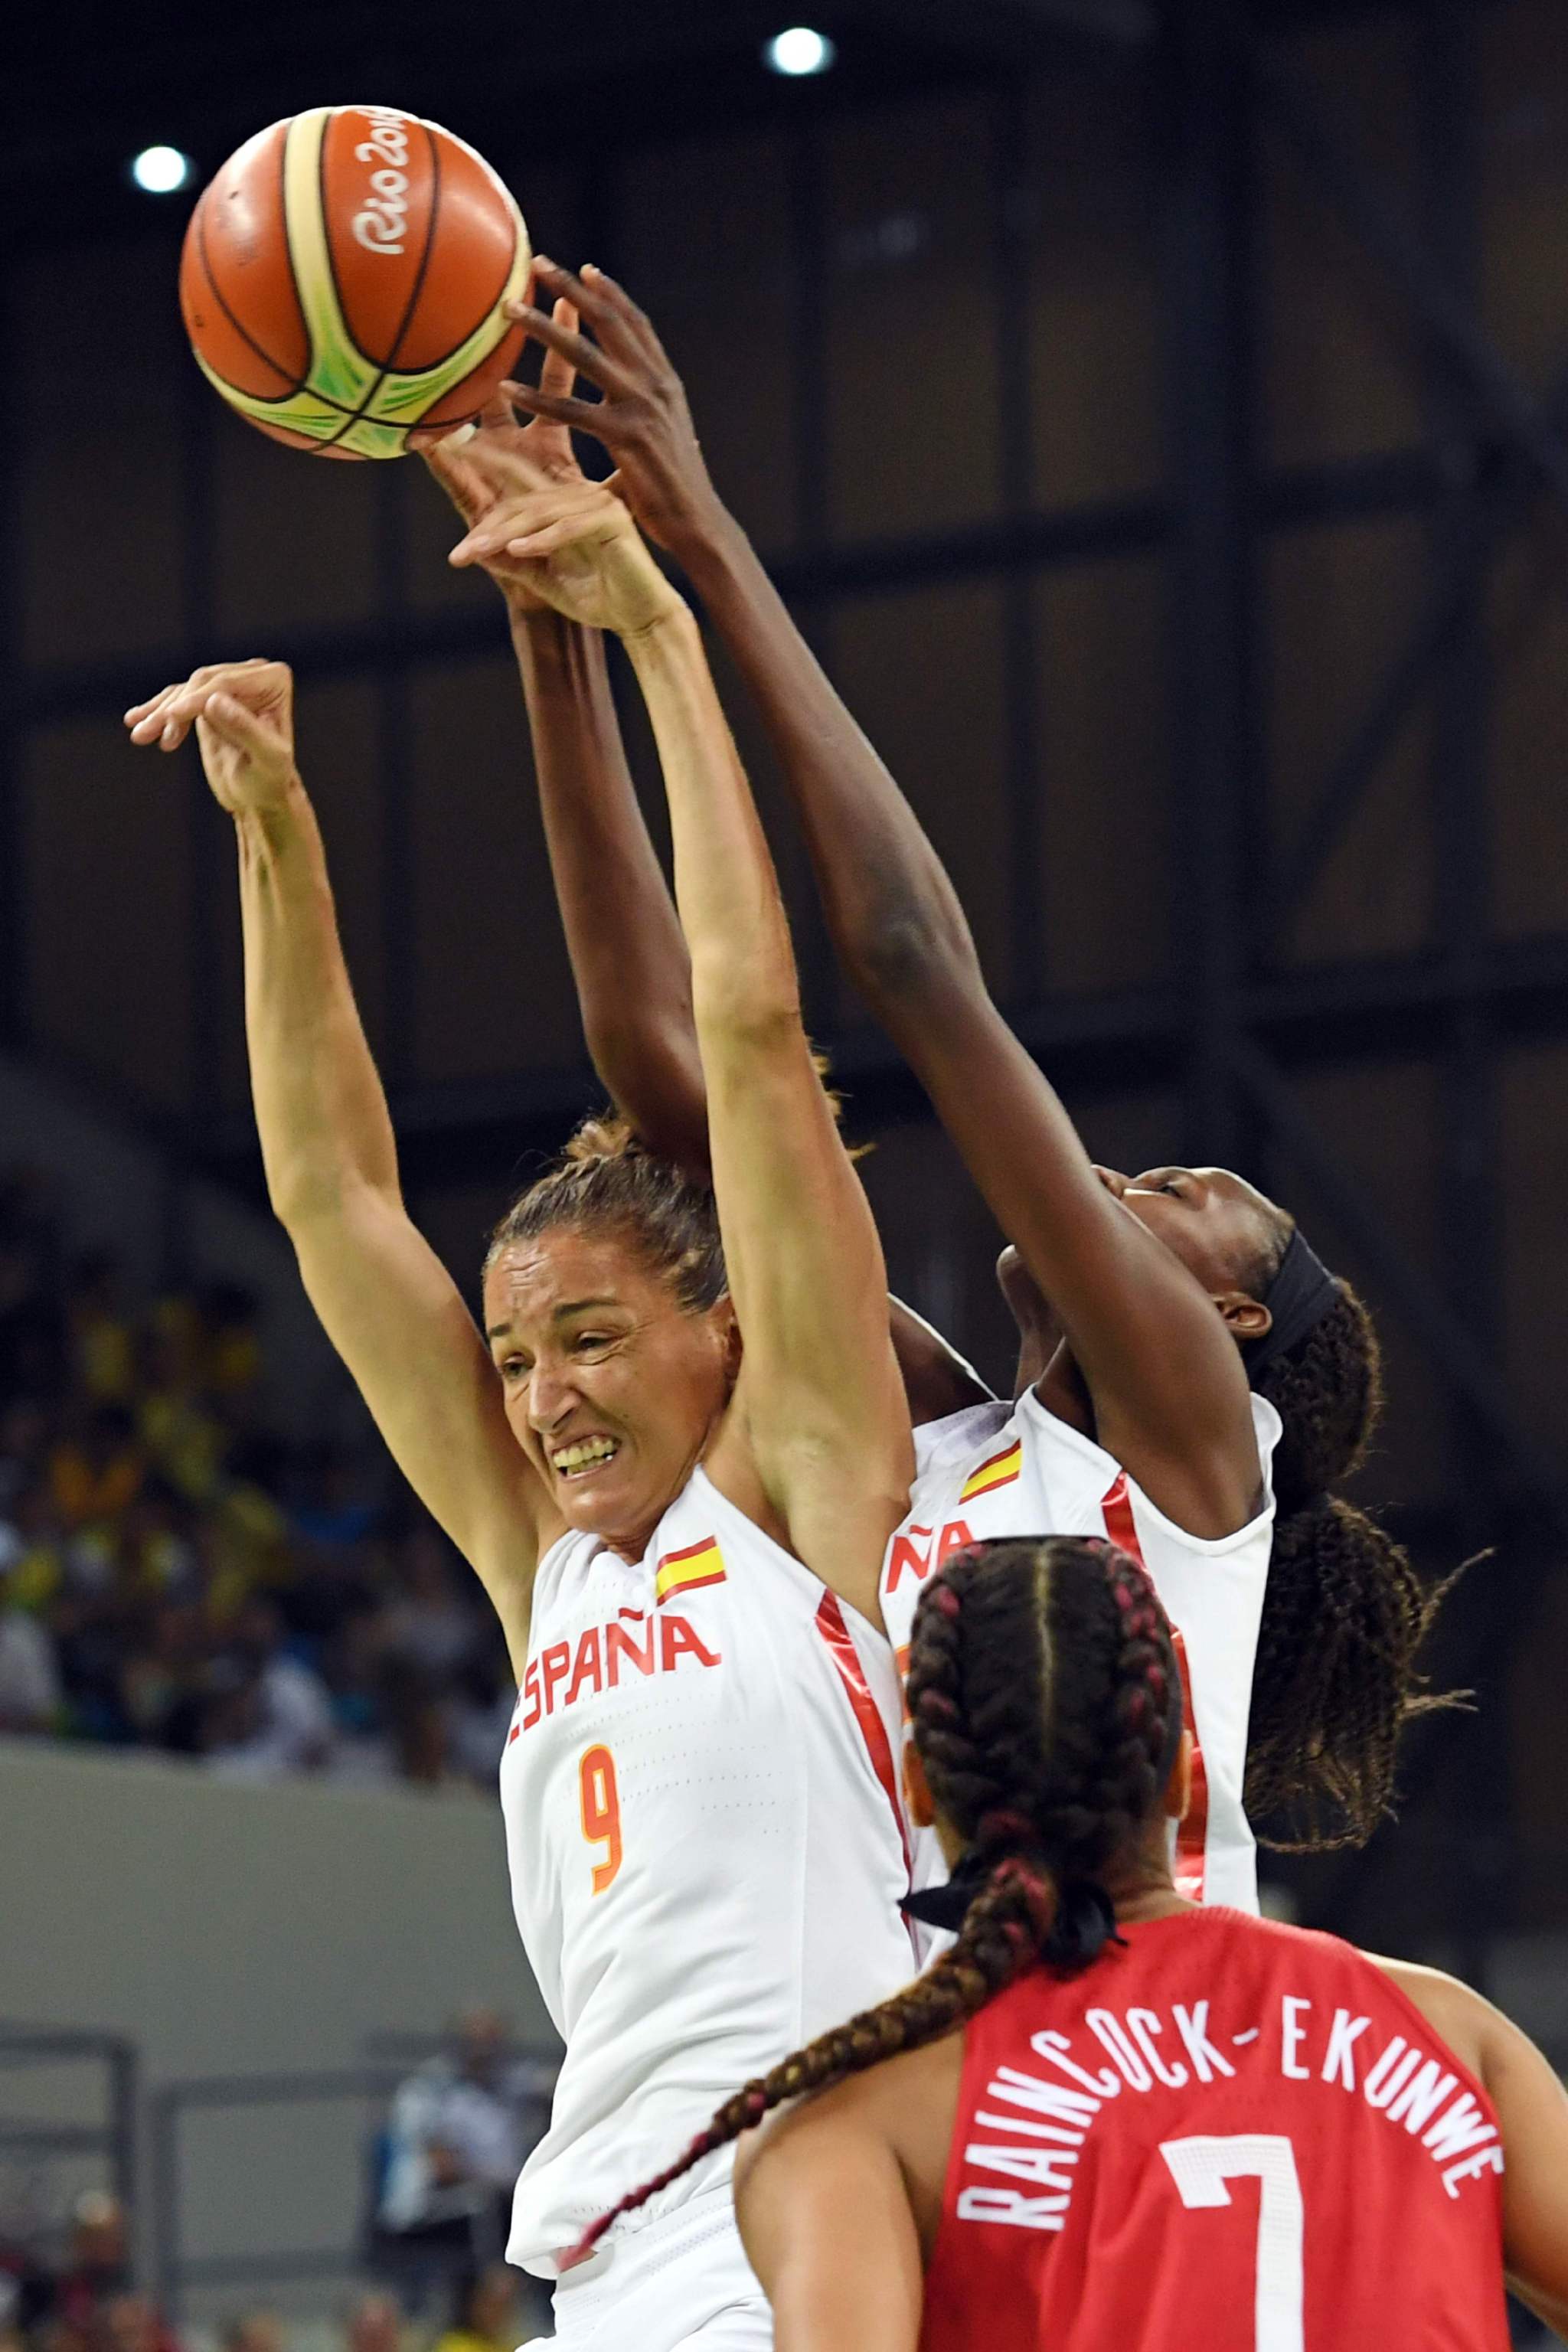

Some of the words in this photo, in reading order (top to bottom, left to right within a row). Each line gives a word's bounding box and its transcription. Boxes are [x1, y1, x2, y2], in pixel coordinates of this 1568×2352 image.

[353, 169, 410, 254] Rio
[578, 1743, 624, 1896] 9
[1158, 2133, 1305, 2352] 7
